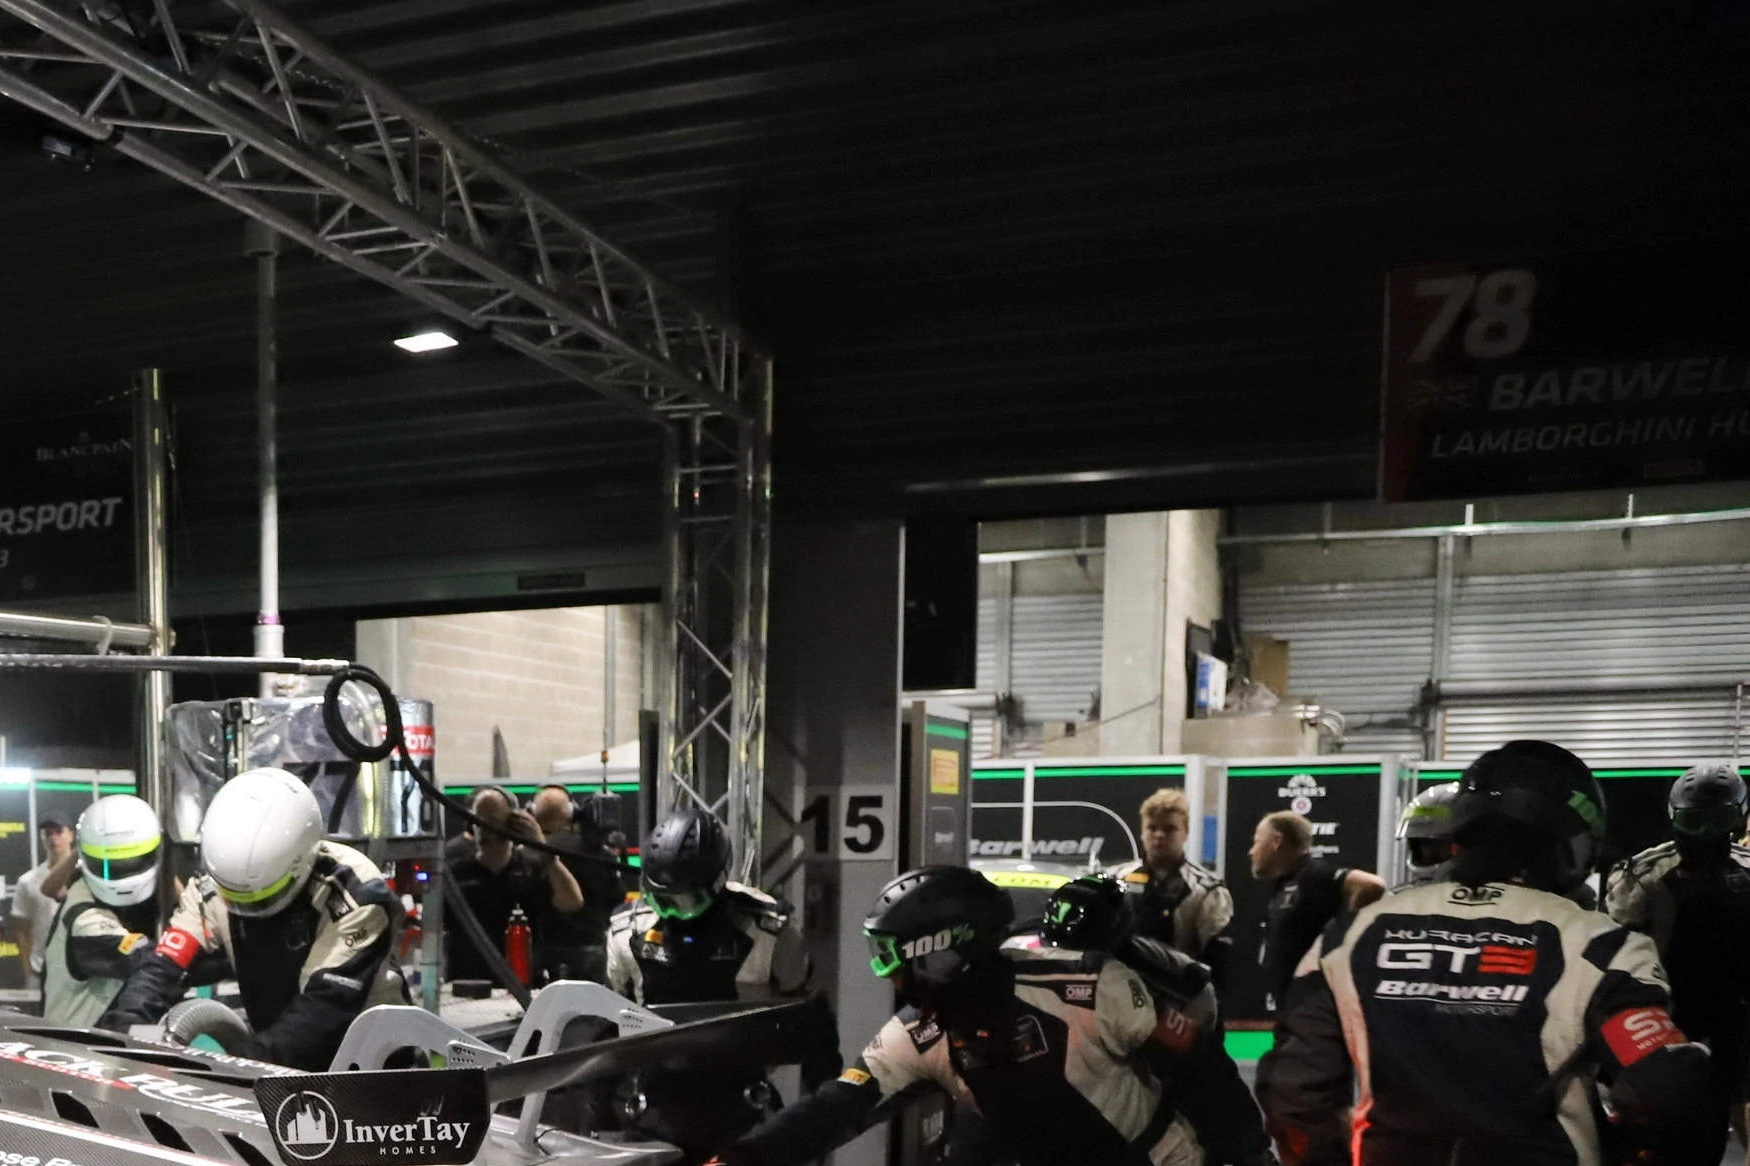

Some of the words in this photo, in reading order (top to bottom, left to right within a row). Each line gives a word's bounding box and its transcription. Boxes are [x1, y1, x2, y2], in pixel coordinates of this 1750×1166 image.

[1406, 268, 1538, 365] 78
[1488, 355, 1750, 412] BARWEL
[1430, 415, 1696, 459] LAMBORGHINI
[404, 730, 435, 752] TOTA
[800, 794, 885, 855] 15
[344, 926, 369, 948] OMP
[901, 921, 975, 960] 100%
[1384, 927, 1538, 946] HURACAN
[1376, 942, 1537, 976] GT3
[1065, 986, 1094, 999] OMP
[1374, 979, 1530, 1002] Barwell
[342, 1115, 471, 1149] InverTay
[379, 1145, 437, 1156] HOMES
